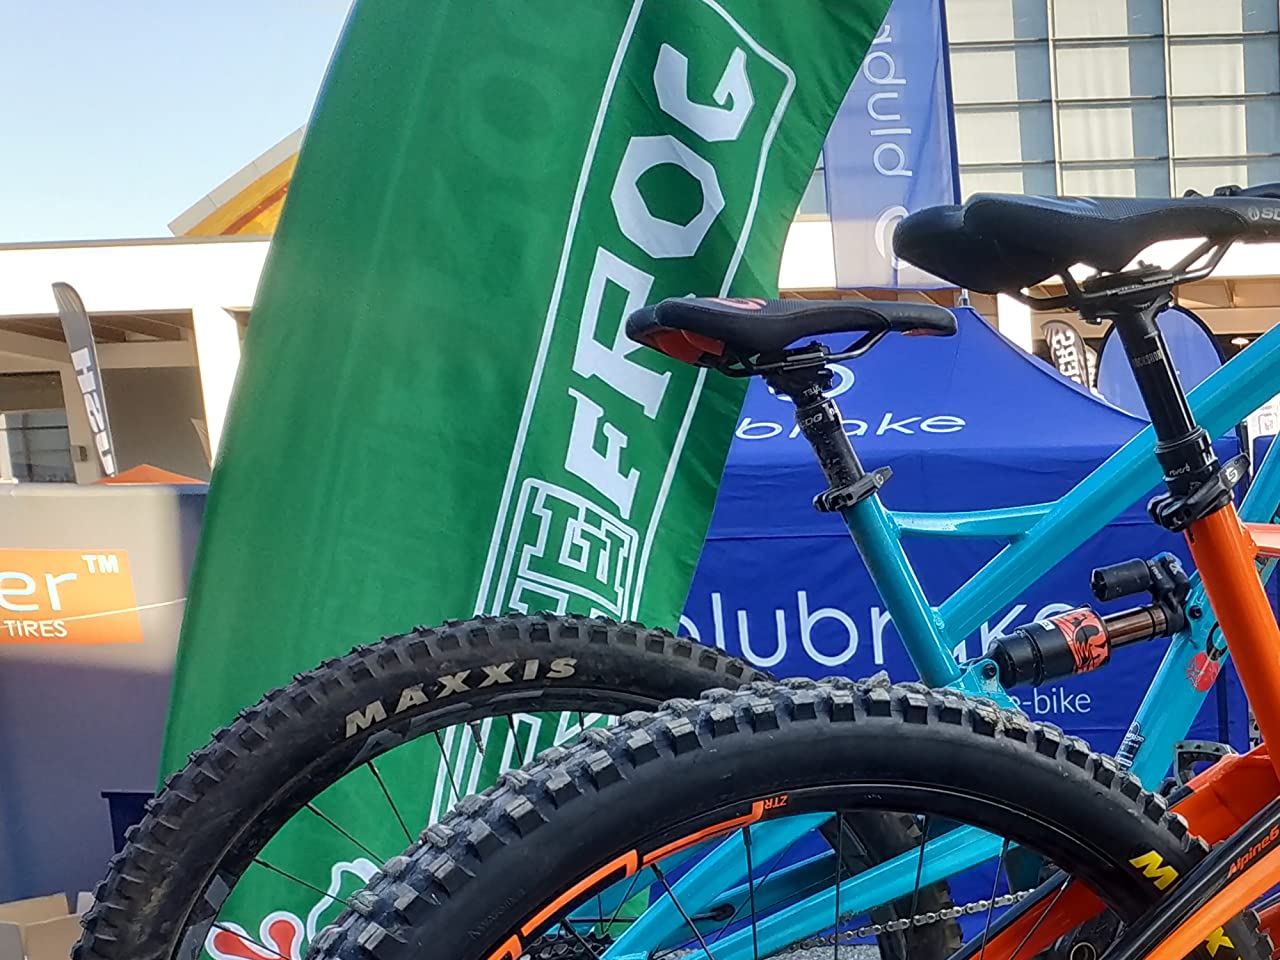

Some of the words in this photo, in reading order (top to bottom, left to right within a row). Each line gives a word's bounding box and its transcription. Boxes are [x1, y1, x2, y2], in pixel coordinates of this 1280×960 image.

[82, 553, 120, 574] TM
[4, 619, 68, 638] TIRES
[344, 656, 578, 739] MAXXIS
[764, 794, 788, 810] ZTR
[1227, 823, 1280, 878] Alpine6
